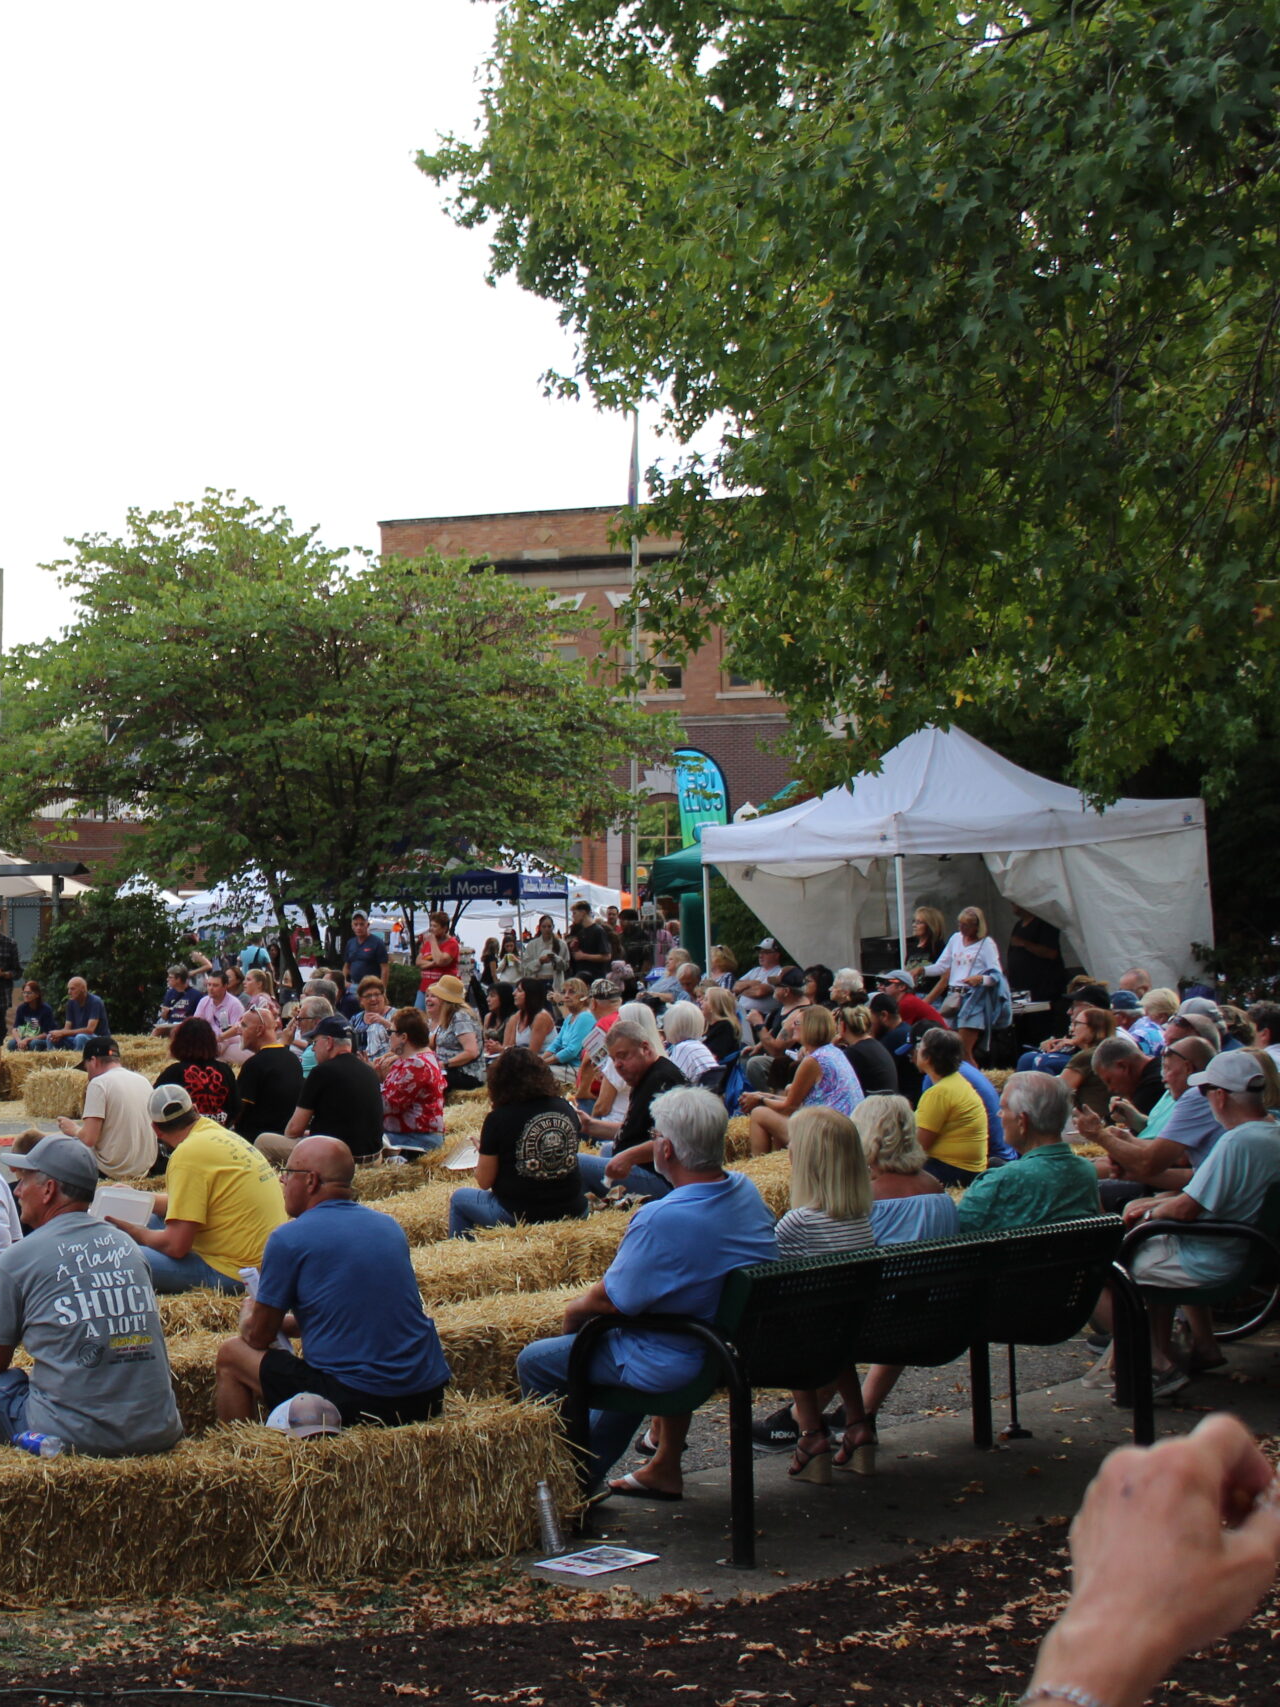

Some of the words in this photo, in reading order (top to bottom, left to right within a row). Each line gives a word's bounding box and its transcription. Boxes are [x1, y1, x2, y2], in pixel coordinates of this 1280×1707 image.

[456, 880, 498, 896] More!
[56, 1263, 70, 1281] A
[70, 1276, 81, 1292] I
[90, 1269, 135, 1288] JUST
[85, 1320, 100, 1338] A
[107, 1314, 147, 1335] LOT!
